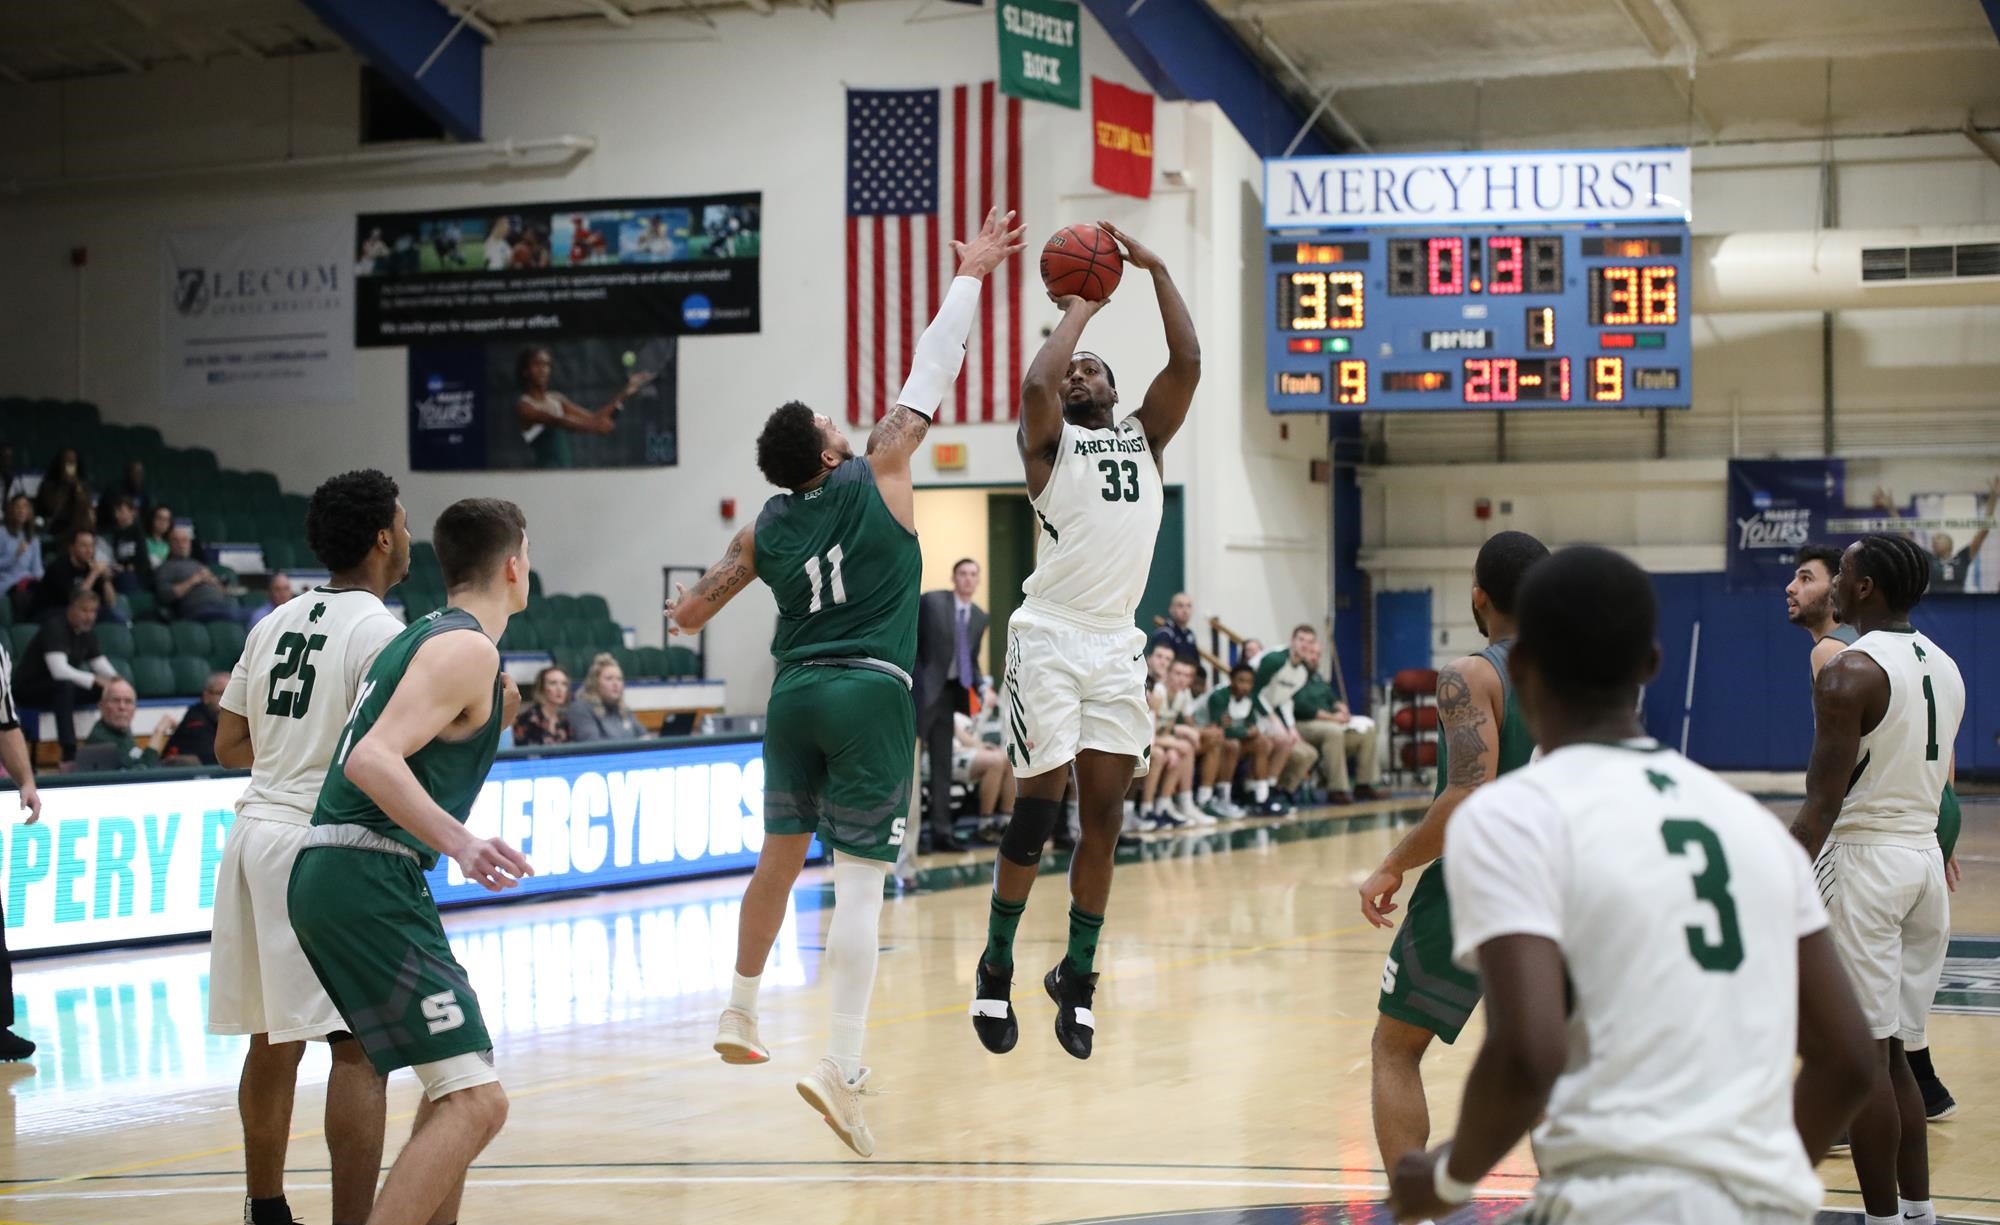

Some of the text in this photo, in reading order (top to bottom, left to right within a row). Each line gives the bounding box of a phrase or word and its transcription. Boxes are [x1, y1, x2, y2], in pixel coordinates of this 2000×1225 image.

[1003, 4, 1074, 47] SLIPPERY
[1022, 50, 1061, 85] ROCK
[1286, 161, 1672, 217] MERCYHURST
[213, 263, 338, 298] LECOM
[1292, 272, 1364, 330] 33
[1603, 266, 1677, 325] 36
[1430, 328, 1486, 352] period
[1543, 307, 1554, 346] 1
[1340, 360, 1366, 404] 9
[1596, 357, 1623, 401] 9
[1098, 459, 1140, 502] 33
[1736, 512, 1810, 551] YOURS
[804, 543, 848, 613] 11
[265, 631, 328, 720] 25
[1923, 675, 1938, 761] 1
[888, 817, 906, 845] S
[0, 811, 181, 929] PERY
[1661, 819, 1745, 972] 3
[420, 989, 466, 1036] S
